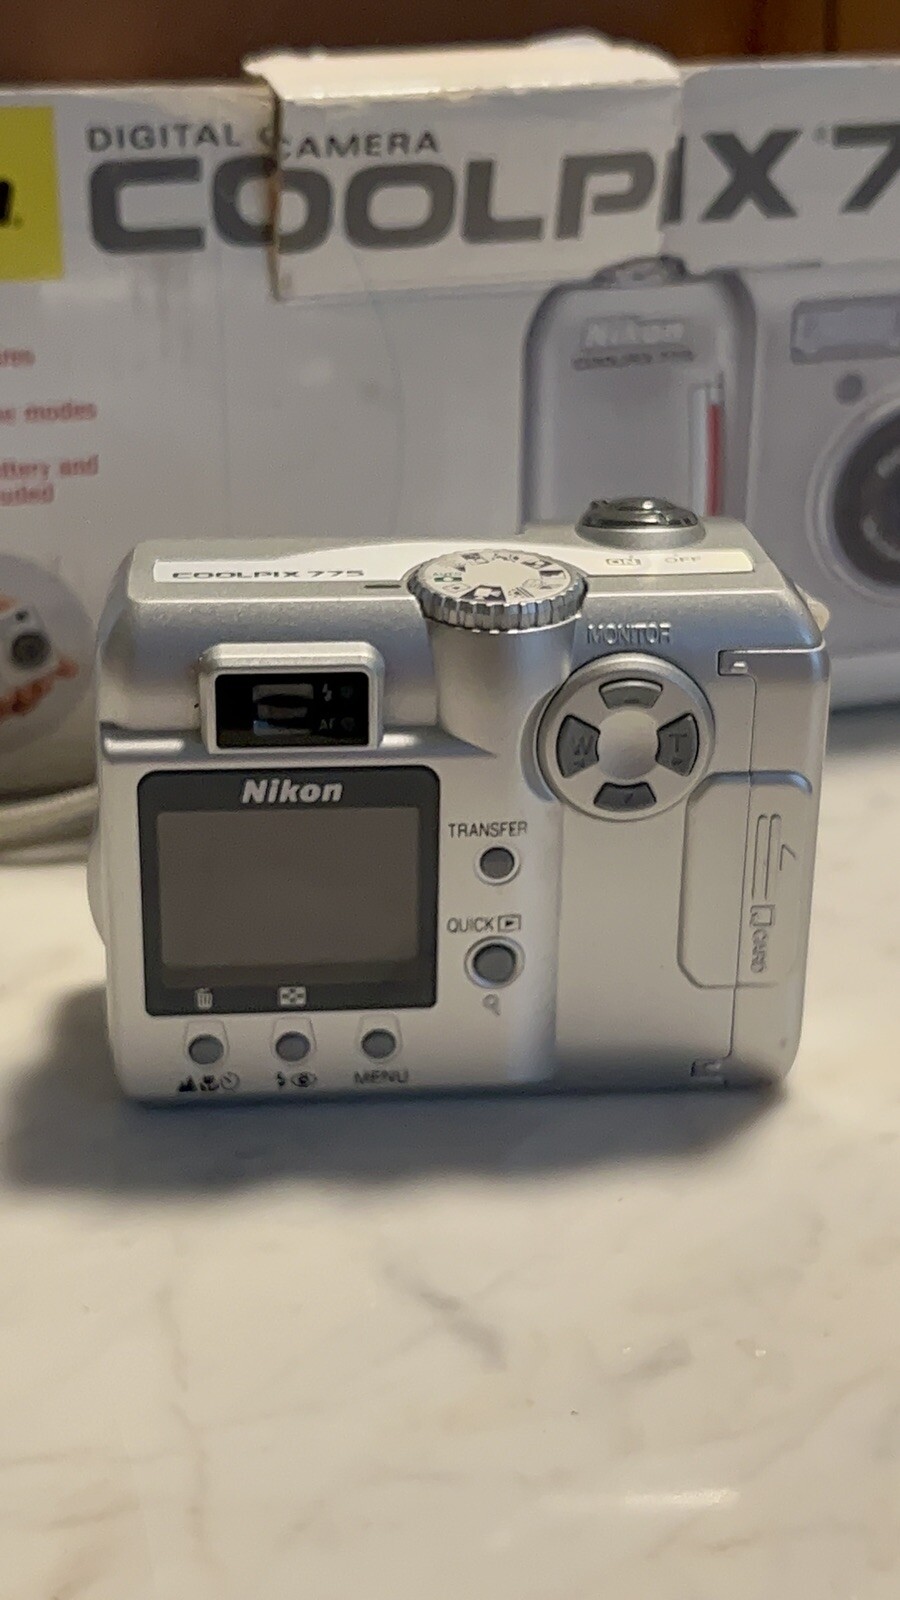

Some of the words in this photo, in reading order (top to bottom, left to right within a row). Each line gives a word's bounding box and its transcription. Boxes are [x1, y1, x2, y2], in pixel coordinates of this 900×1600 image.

[87, 122, 240, 152] DIGITAL
[256, 127, 440, 159] CAMERA
[89, 129, 801, 254] COOLPIX
[60, 454, 99, 475] and
[172, 570, 299, 580] COOLPIX
[306, 569, 364, 578] 775
[586, 621, 671, 645] MONITOR
[666, 733, 689, 754] T
[241, 778, 344, 805] Nikon
[448, 821, 528, 839] TRANSFER
[447, 916, 495, 933] QUICK
[354, 1069, 409, 1085] MENU
